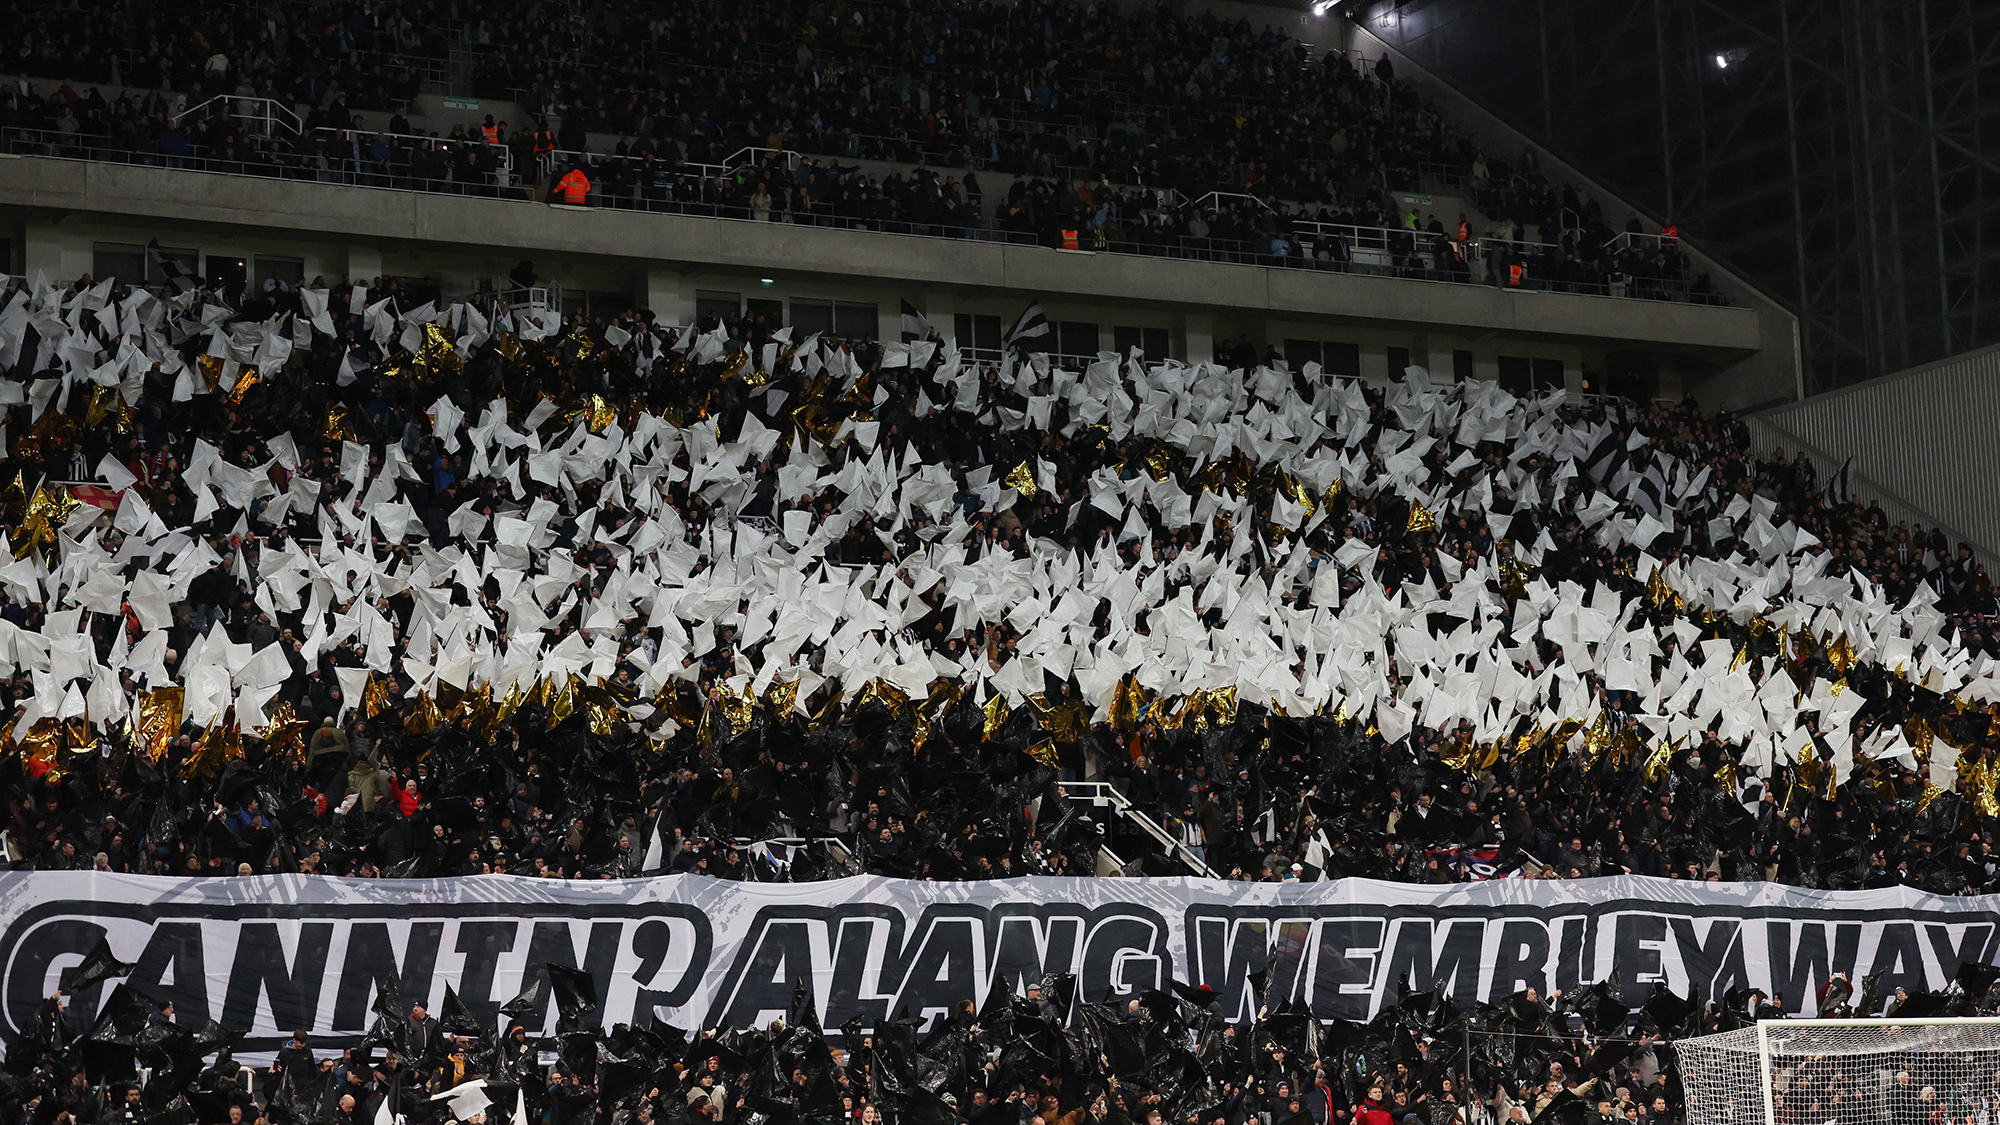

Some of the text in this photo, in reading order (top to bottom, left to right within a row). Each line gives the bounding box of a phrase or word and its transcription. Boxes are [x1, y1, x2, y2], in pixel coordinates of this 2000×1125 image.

[716, 918, 1157, 1031] ALANG
[1198, 915, 1740, 1021] WEMBLEY
[1766, 921, 1994, 1014] WAY
